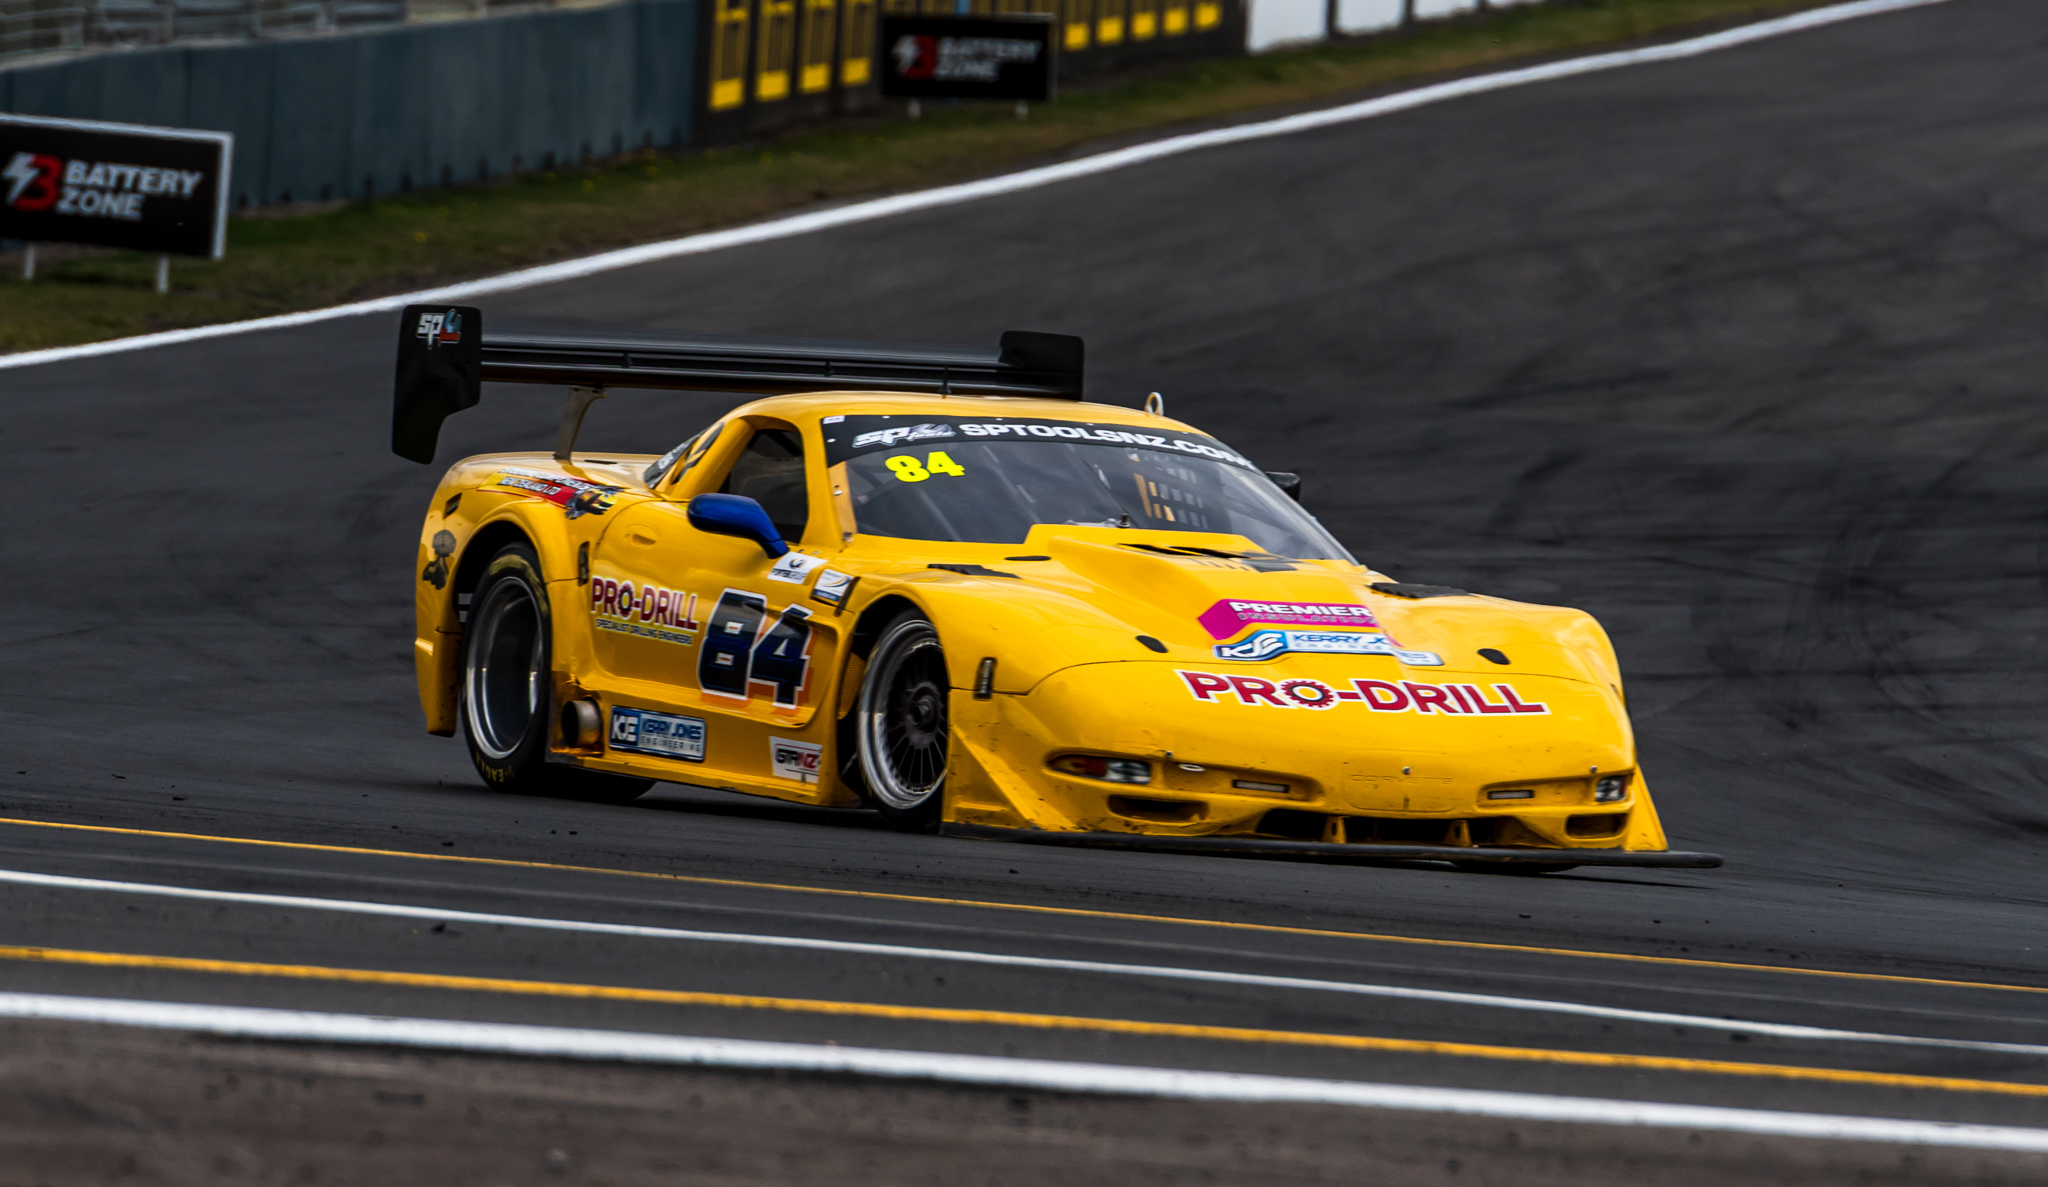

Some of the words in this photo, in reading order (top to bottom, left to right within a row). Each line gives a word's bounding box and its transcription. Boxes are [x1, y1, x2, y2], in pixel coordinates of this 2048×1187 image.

[64, 158, 203, 198] BATTERY
[54, 186, 146, 221] ZONE
[885, 451, 966, 482] 84
[591, 575, 699, 632] PRO-DRILL
[1228, 602, 1372, 618] PREMIER
[698, 588, 813, 709] 84
[1293, 634, 1361, 643] KERRY
[1177, 670, 1549, 714] PRO-DRILL
[642, 719, 673, 736] KERRY
[671, 723, 702, 741] JONES
